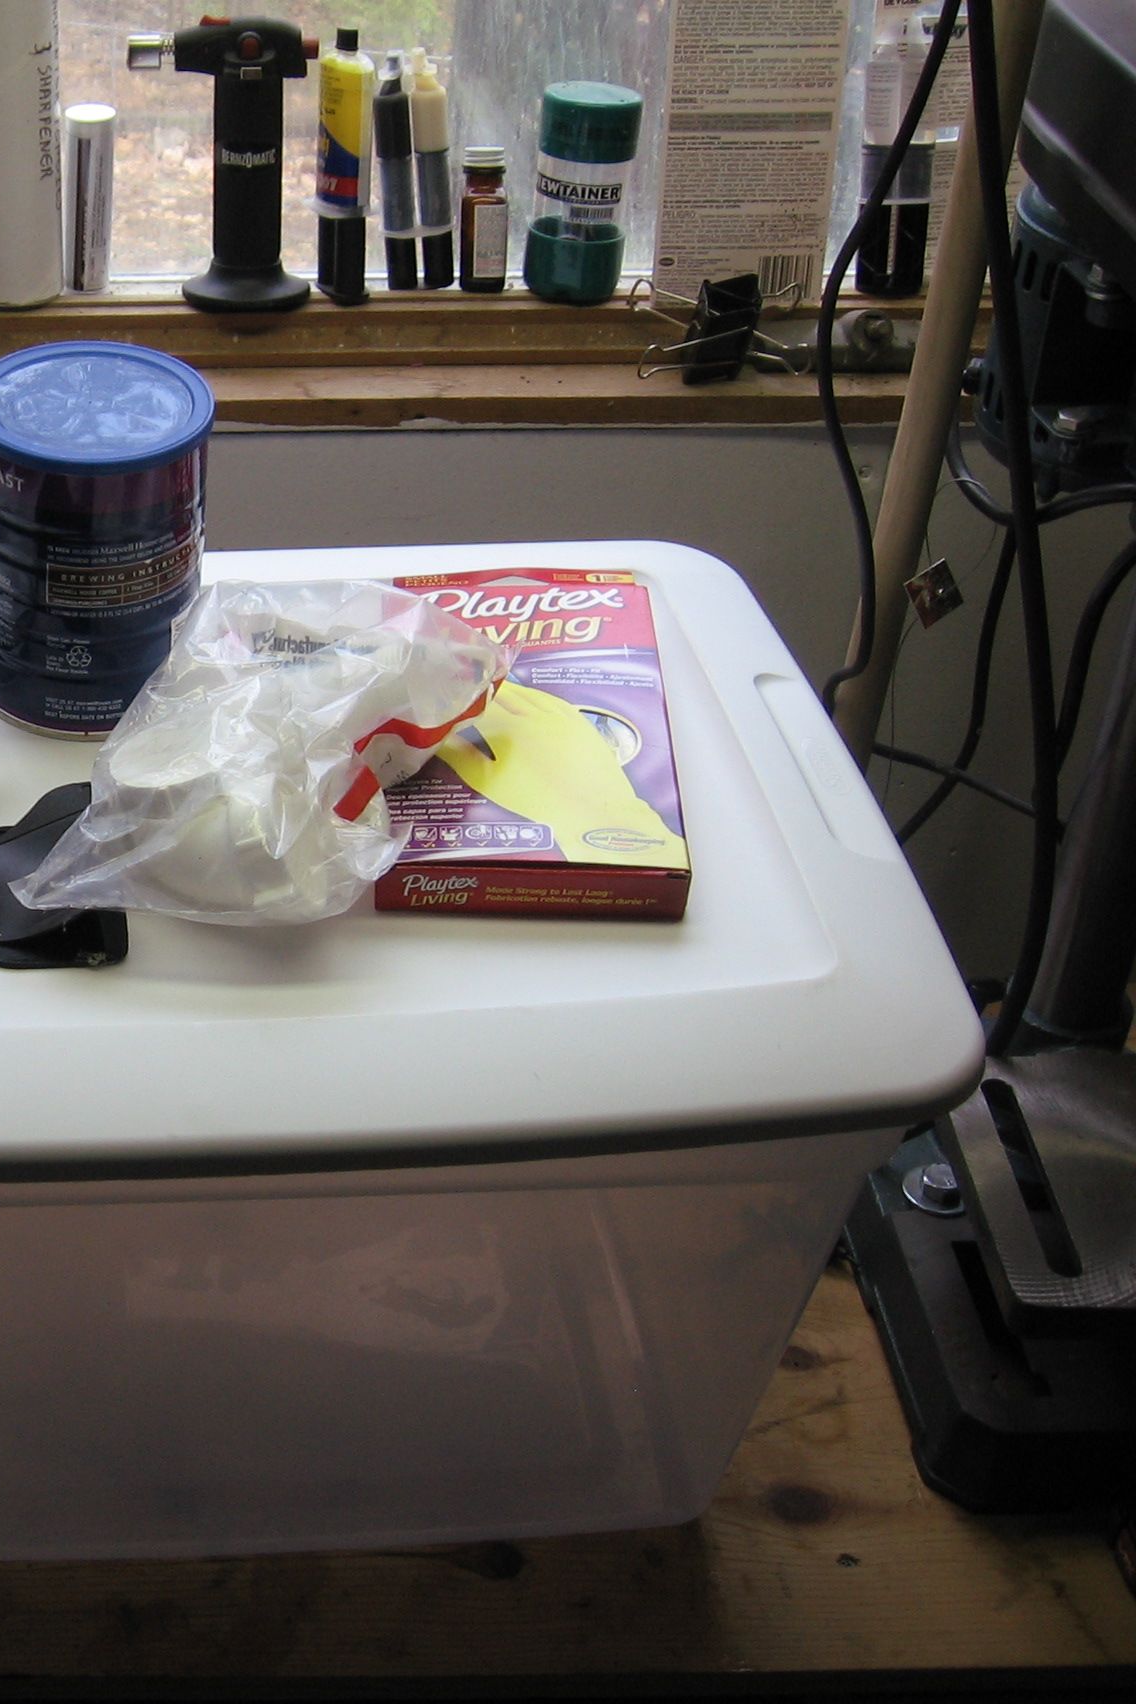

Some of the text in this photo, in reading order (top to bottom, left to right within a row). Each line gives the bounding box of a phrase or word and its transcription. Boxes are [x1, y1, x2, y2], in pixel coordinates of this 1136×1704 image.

[37, 65, 54, 181] SHARPENER
[61, 573, 125, 582] BREWING
[416, 586, 624, 621] Playtex
[402, 874, 478, 897] Playtex
[411, 889, 469, 906] Living
